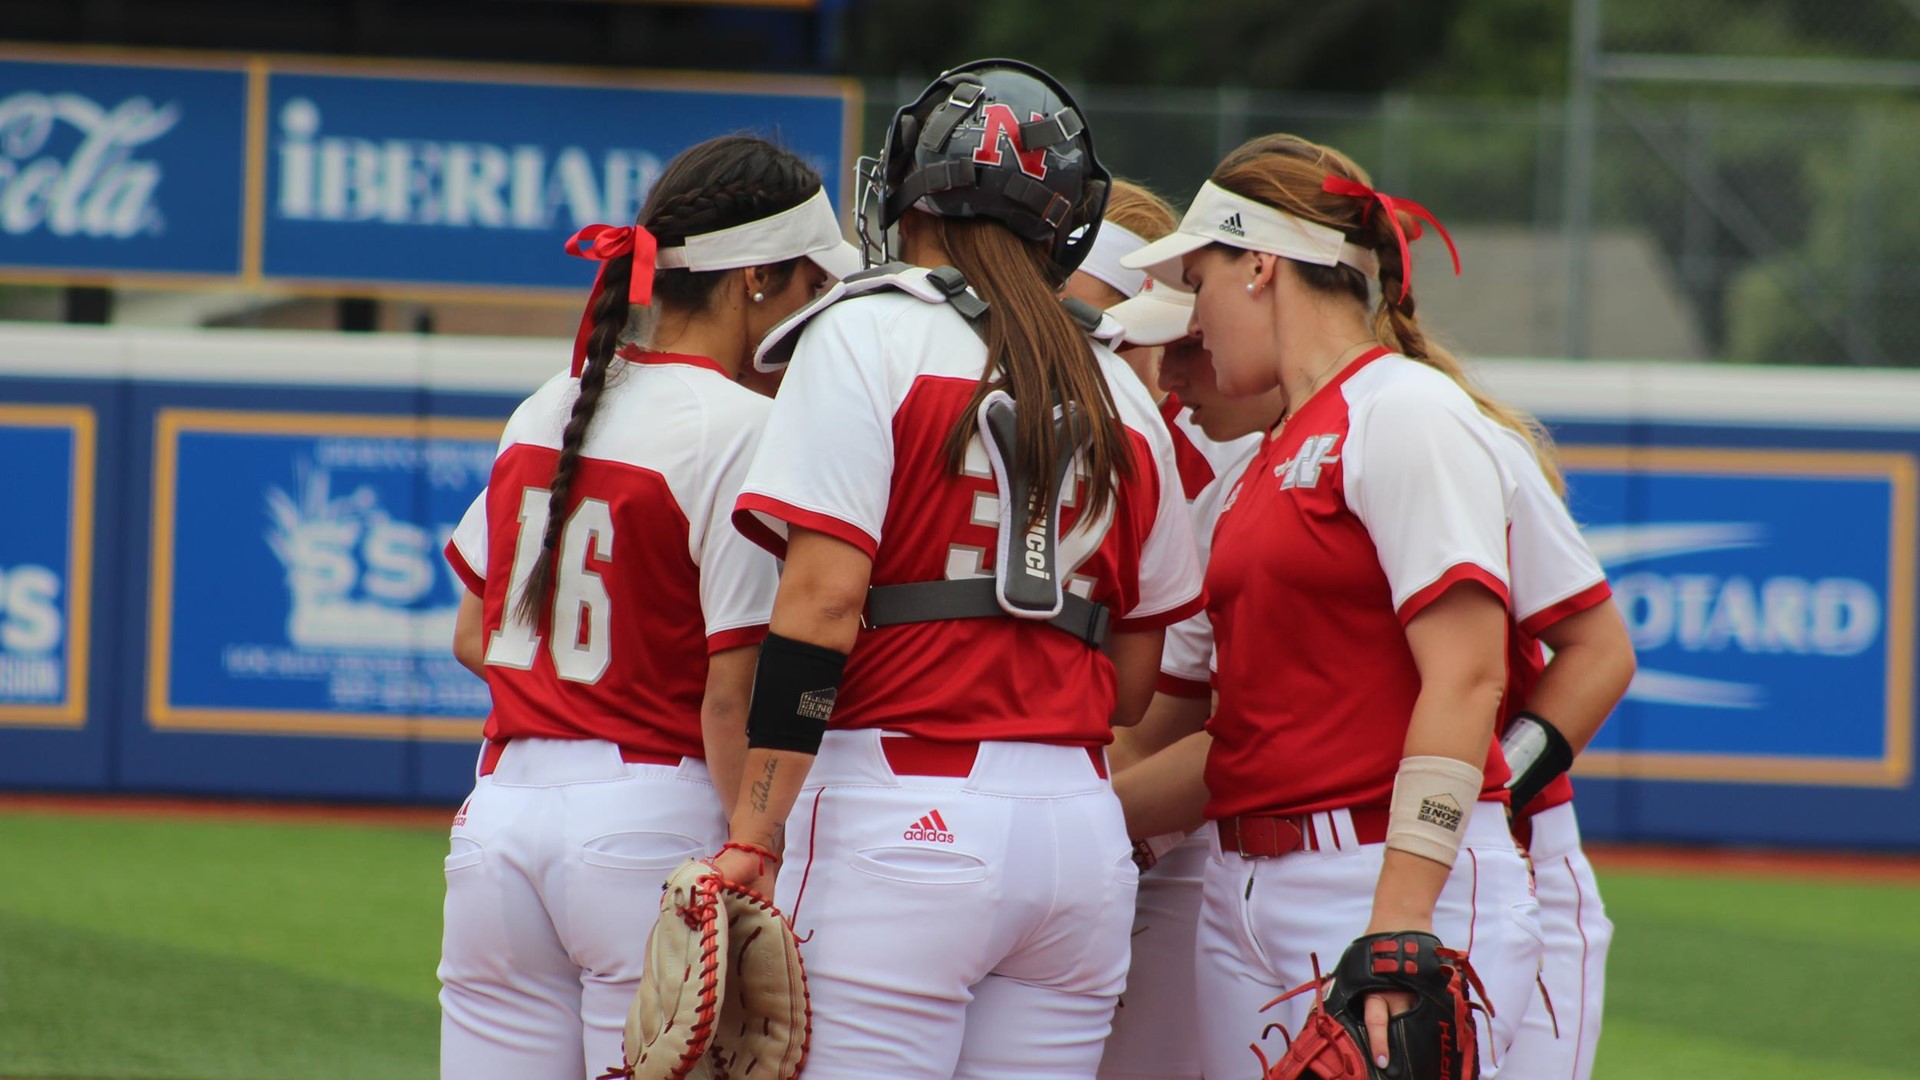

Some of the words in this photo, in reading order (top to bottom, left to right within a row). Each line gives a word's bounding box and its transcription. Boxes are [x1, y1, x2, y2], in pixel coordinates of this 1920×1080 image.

[972, 102, 1048, 181] N
[1219, 224, 1245, 237] adidas
[292, 516, 458, 605] SS
[1024, 480, 1051, 581] ucci
[0, 562, 61, 651] S
[484, 483, 614, 686] 16
[903, 828, 954, 844] adidas
[1420, 805, 1460, 825] ZONE
[1438, 1020, 1452, 1080] RTH
